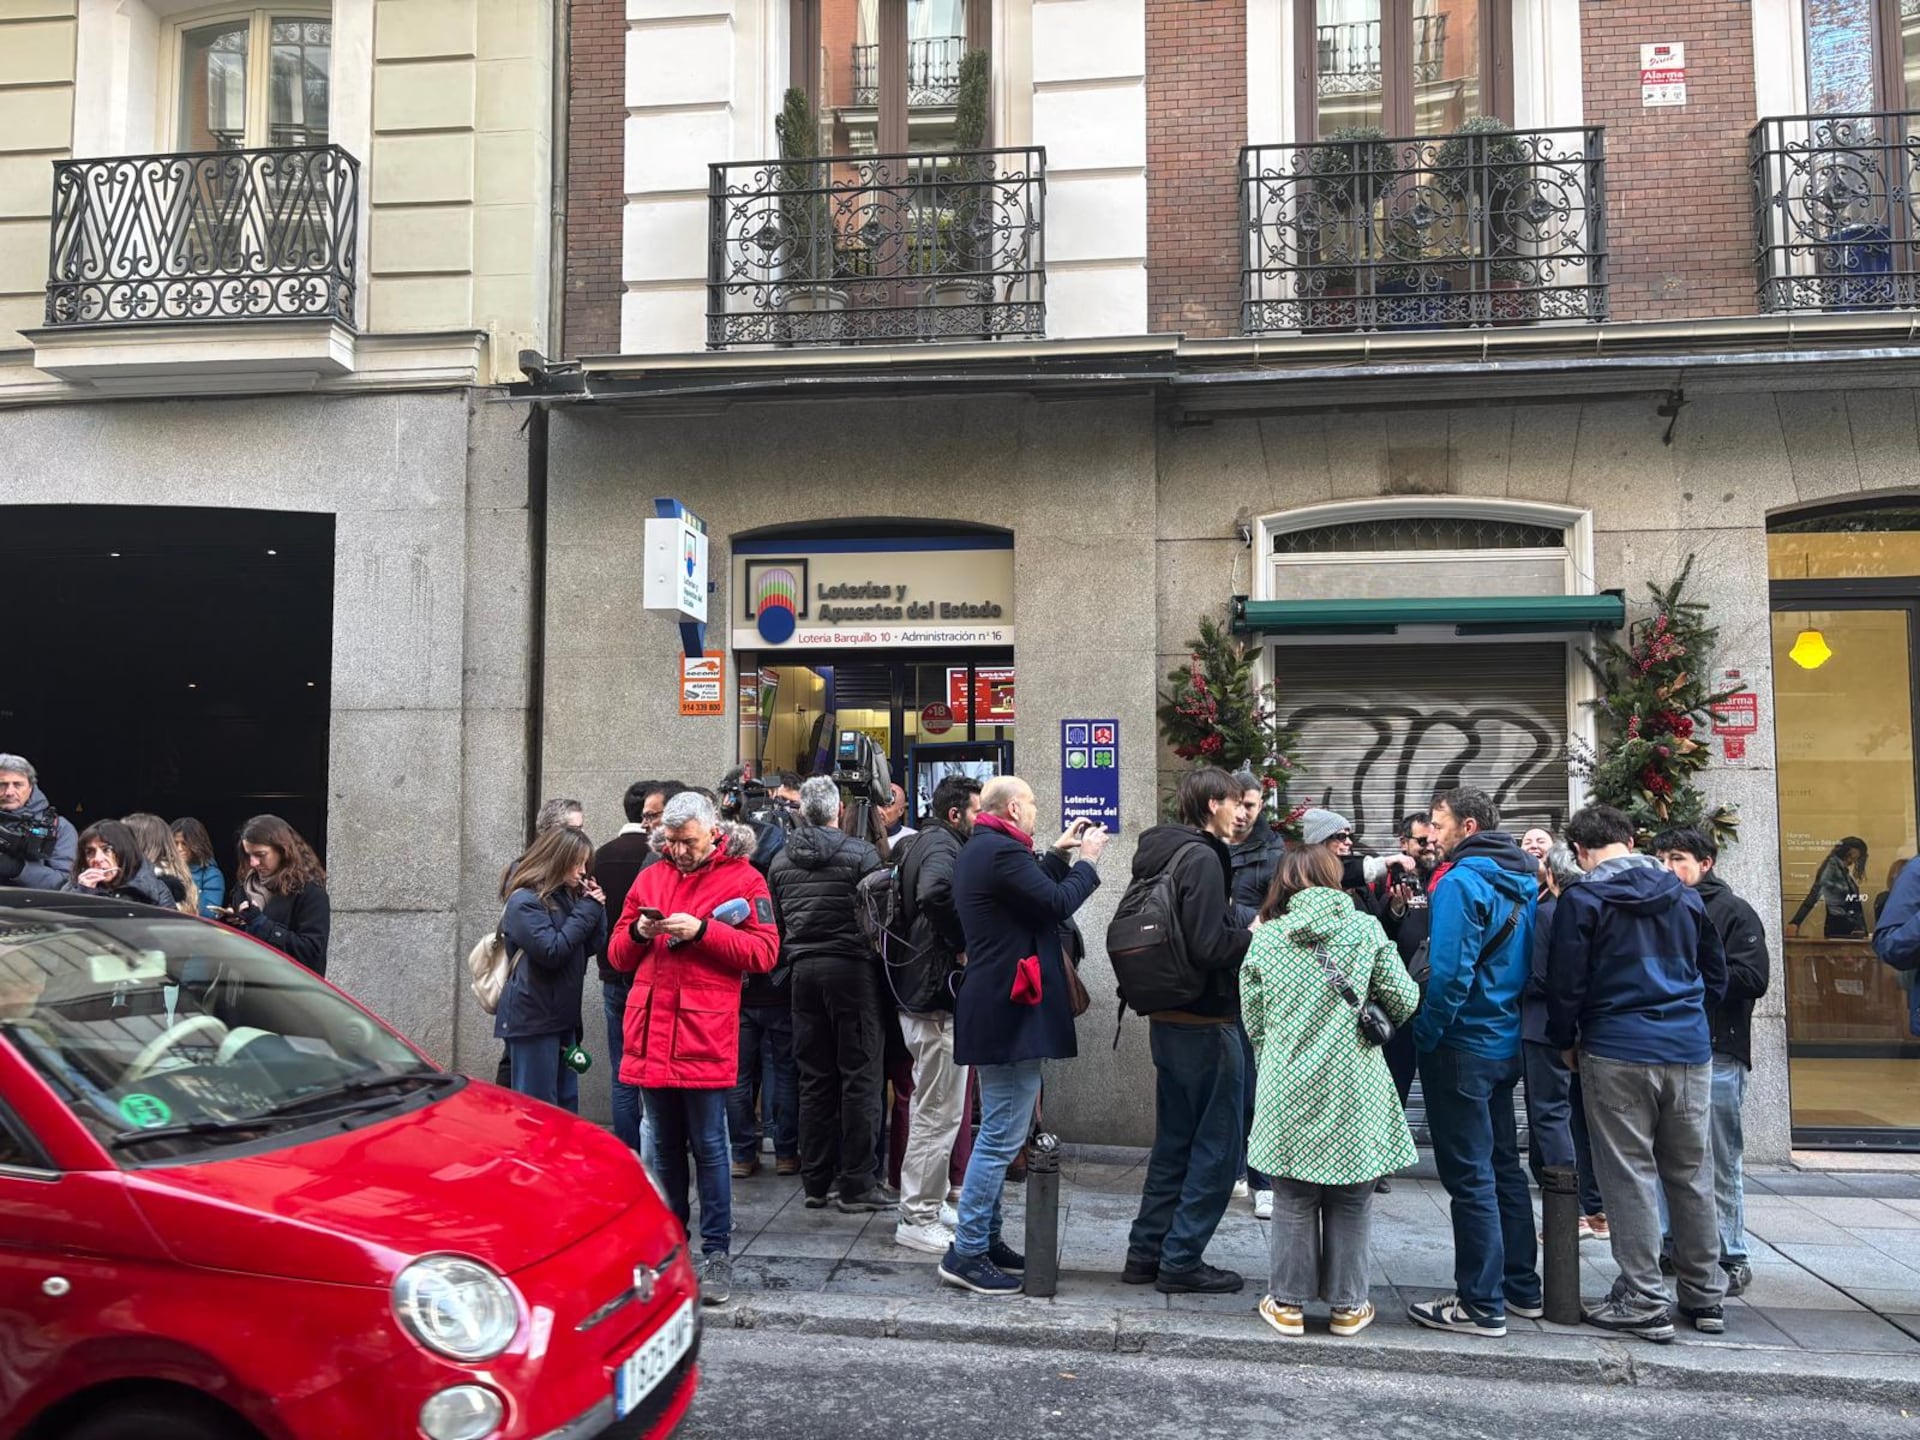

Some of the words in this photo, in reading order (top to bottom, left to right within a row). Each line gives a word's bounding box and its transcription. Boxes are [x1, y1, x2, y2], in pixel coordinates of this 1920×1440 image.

[1643, 71, 1684, 80] Alarma
[896, 585, 907, 603] y
[819, 604, 903, 625] Apuestas
[906, 601, 935, 620] del
[940, 600, 1002, 620] Estado
[834, 632, 877, 645] Barquillo
[880, 632, 891, 642] 10
[901, 631, 976, 642] Administración
[992, 631, 1002, 641] 16
[683, 703, 694, 711] 914
[1100, 797, 1105, 805] y
[1064, 807, 1102, 818] Apuestas
[1104, 807, 1117, 816] del
